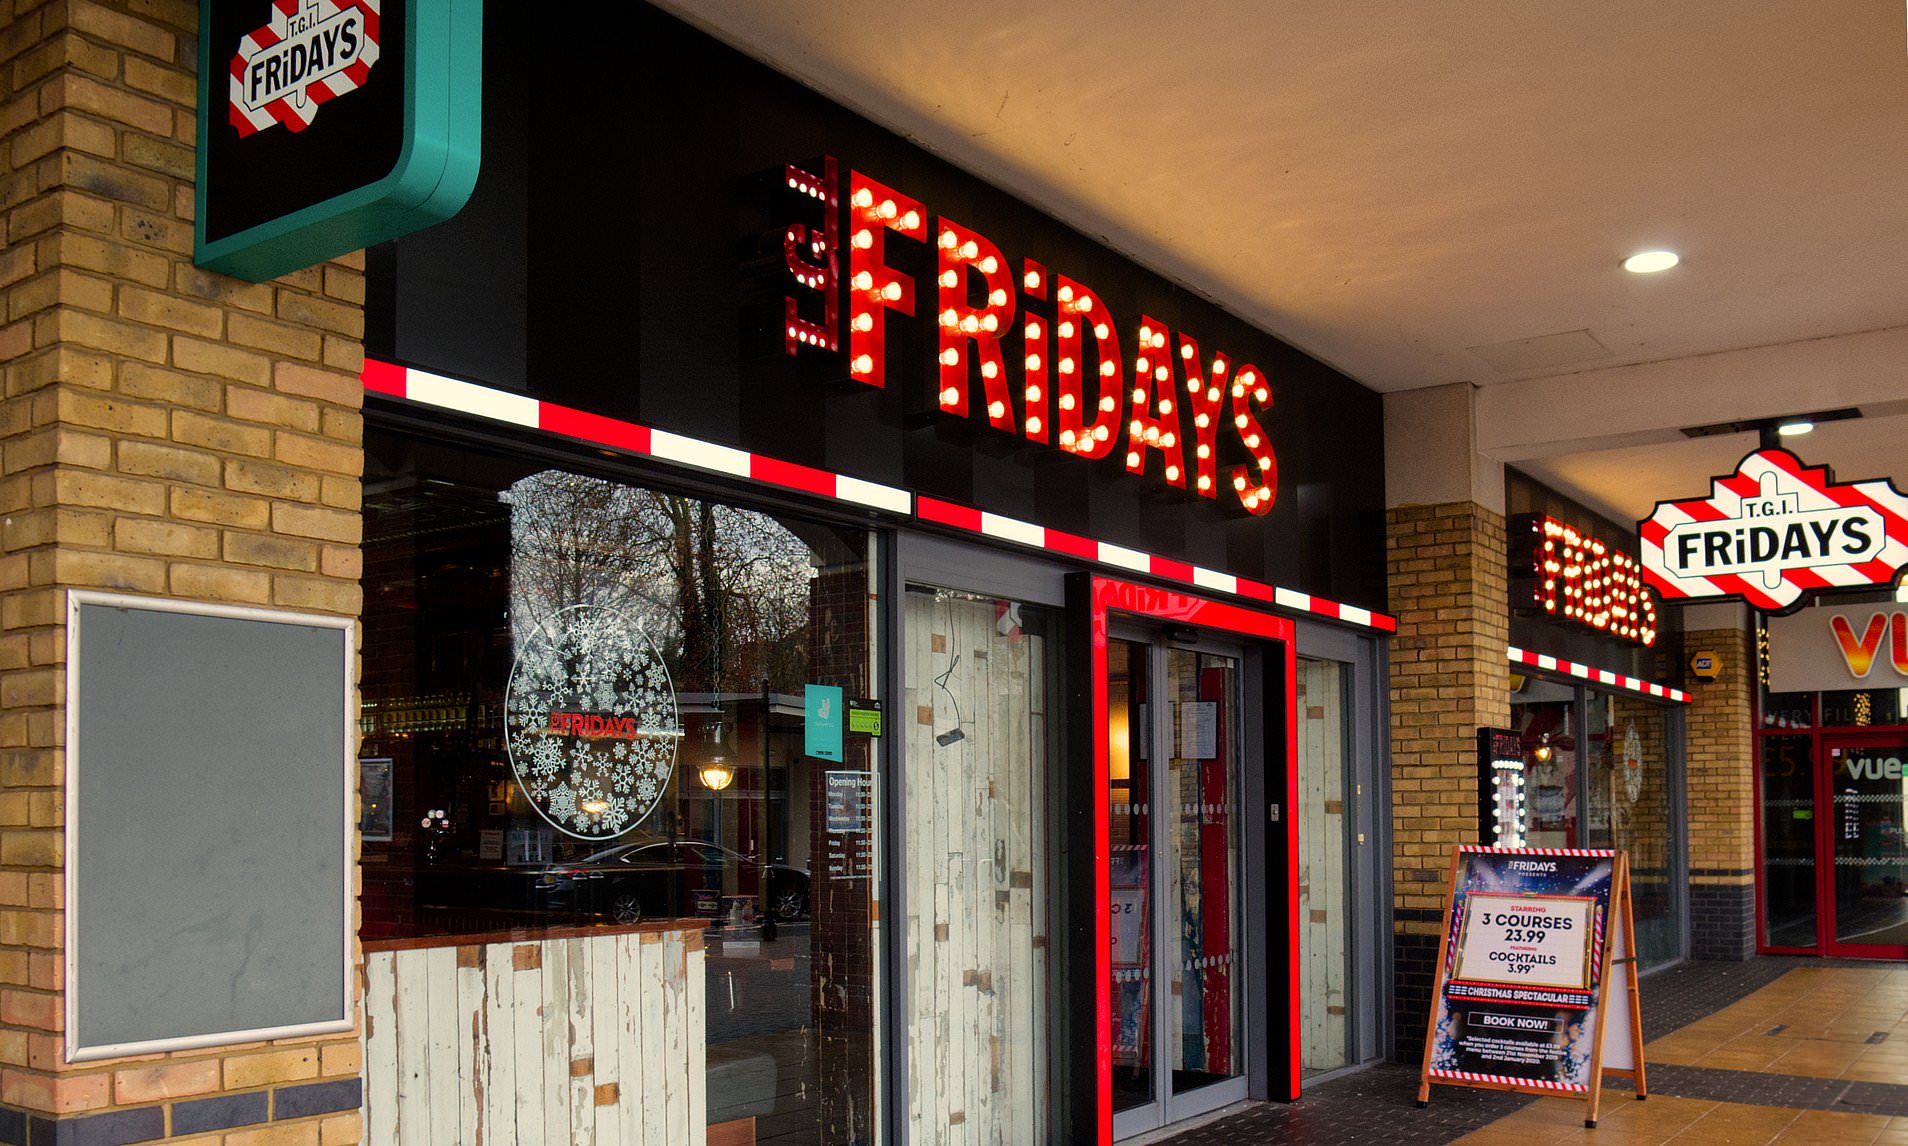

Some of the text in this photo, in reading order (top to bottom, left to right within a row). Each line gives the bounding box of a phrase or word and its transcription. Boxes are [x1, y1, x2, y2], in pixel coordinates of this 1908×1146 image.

[289, 16, 317, 37] T.G.I.
[1746, 500, 1793, 518] T.G.I.
[1846, 757, 1902, 780] vue
[829, 777, 856, 788] Opening
[1513, 860, 1557, 872] FRIDAYS
[1510, 905, 1546, 913] STARRING
[1482, 913, 1573, 930] 3 COURSES
[1504, 929, 1546, 943] 23.99
[1489, 951, 1557, 965] COCKTAILS
[1468, 987, 1569, 1003] CHRISTMAS SPECTACULAR
[1483, 1016, 1548, 1030] BOOK NOW!
